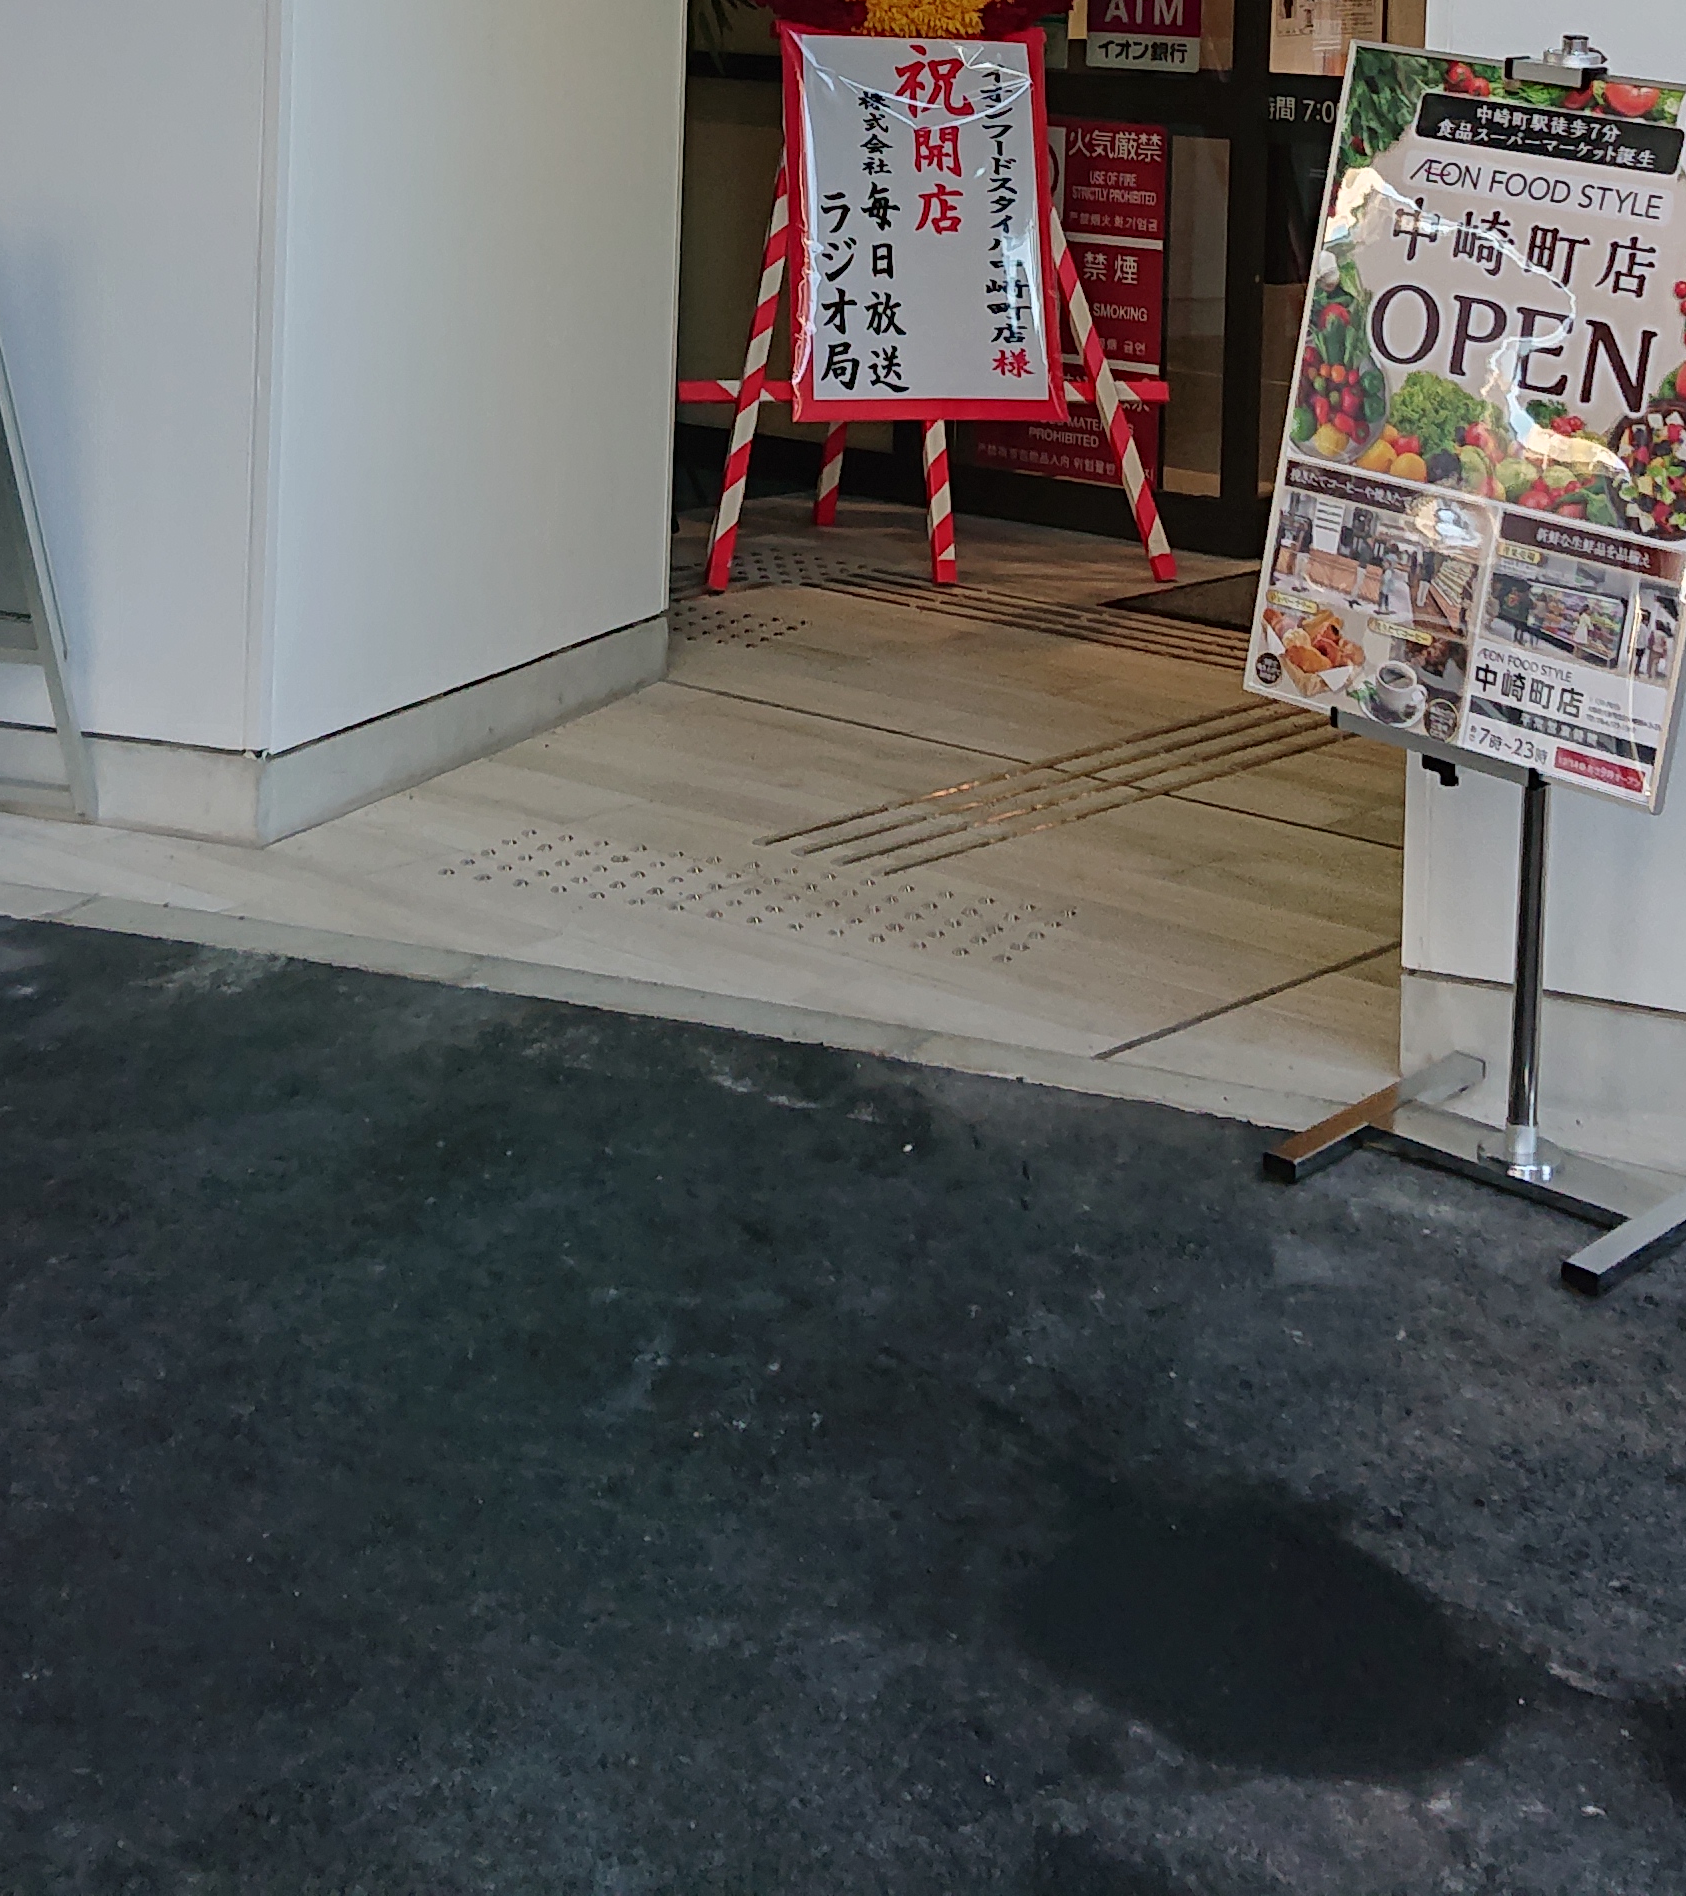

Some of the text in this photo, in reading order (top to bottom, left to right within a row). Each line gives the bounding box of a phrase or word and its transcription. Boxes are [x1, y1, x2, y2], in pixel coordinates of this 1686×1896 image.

[1098, 40, 1188, 64] イオン銀行
[1303, 100, 1338, 123] 7:0
[1476, 105, 1622, 143] 中崎町駅徒歩7分
[895, 44, 975, 235] 祝開店
[1068, 127, 1162, 163] 火気厳禁
[1436, 117, 1656, 169] 食品スーパーマーケット誕生
[1072, 186, 1157, 206] STRICTLY PROHIBITED
[1089, 170, 1137, 187] USE OF FIRE
[1489, 169, 1571, 204] FOOD
[1577, 184, 1665, 220] STYLE
[1392, 196, 1657, 298] 中崎町店
[1083, 251, 1139, 285] 禁煙
[820, 191, 860, 391] ラジオ局
[1093, 304, 1148, 322] SMOKING
[1371, 284, 1658, 413] OPEN
[1029, 426, 1099, 448] PROHIBITED
[1507, 655, 1539, 673] FOOD
[1540, 665, 1574, 684] STYLE
[1475, 663, 1585, 719] 中崎町店
